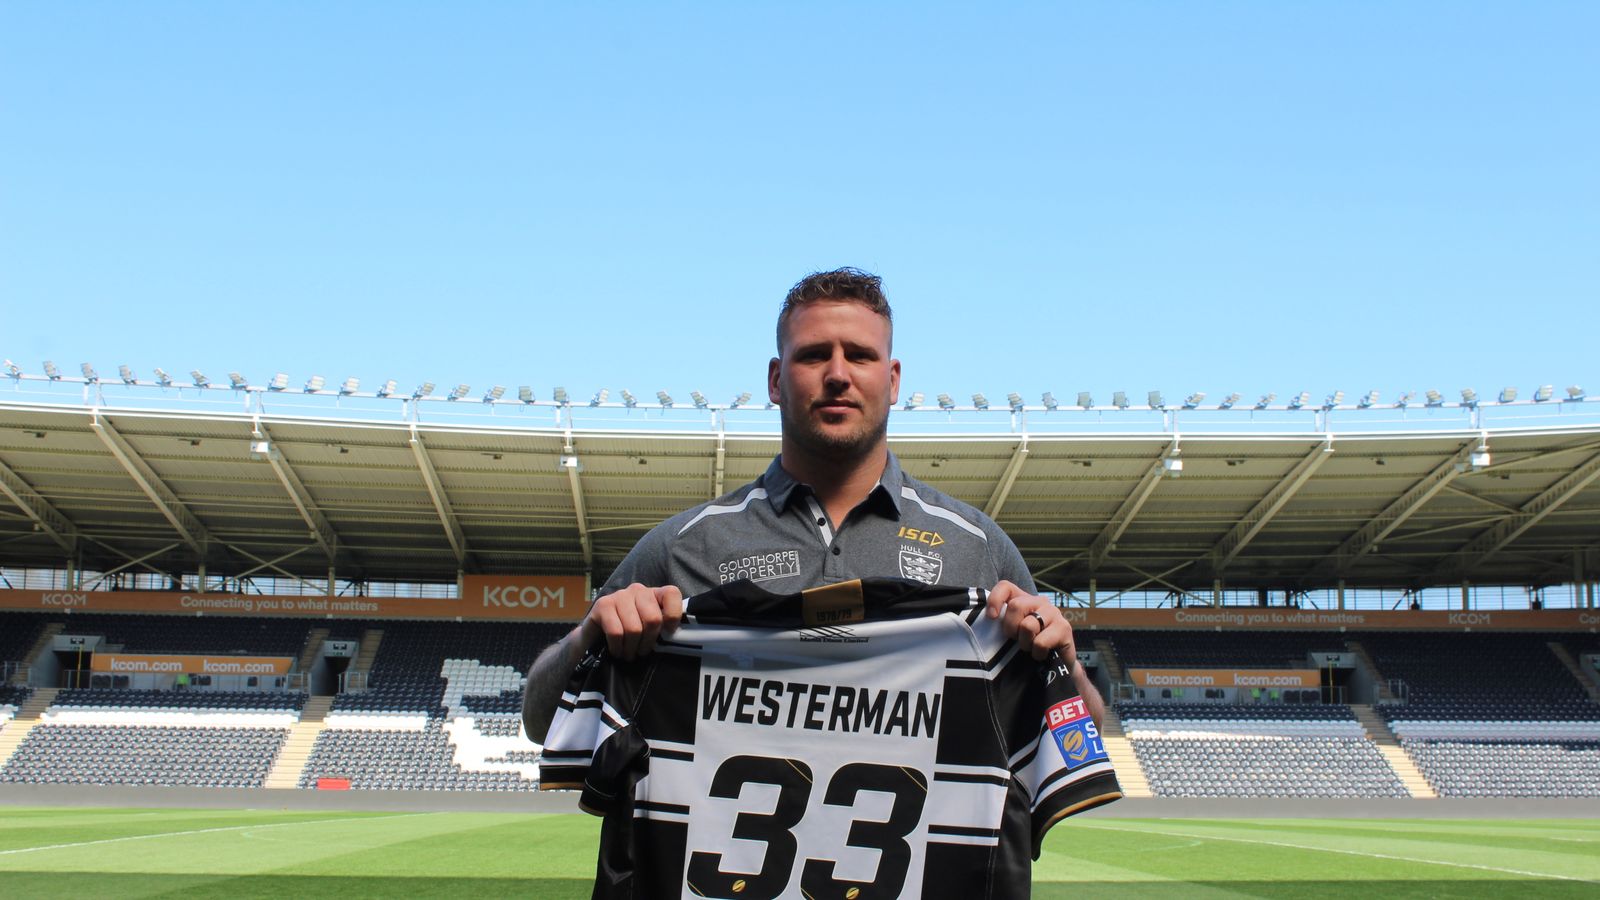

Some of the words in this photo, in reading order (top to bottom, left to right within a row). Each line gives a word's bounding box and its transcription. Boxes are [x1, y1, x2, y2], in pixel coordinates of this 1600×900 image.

[898, 526, 933, 544] ISC
[900, 544, 922, 555] HULL
[718, 550, 796, 574] GOLDTHORPE
[720, 561, 795, 585] PROPERTY
[42, 593, 87, 606] KCOM
[181, 595, 253, 611] Connecting
[256, 599, 279, 611] you
[282, 598, 294, 610] to
[297, 599, 328, 610] what
[331, 600, 379, 611] matters
[483, 585, 565, 609] KCOM
[1063, 610, 1087, 621] OM
[1175, 611, 1245, 625] Connecting
[1248, 613, 1269, 625] you
[1272, 612, 1284, 623] to
[1286, 612, 1317, 624] what
[1319, 612, 1365, 624] matters
[1449, 613, 1490, 625] KCOM
[111, 657, 182, 671] kcom.com
[203, 659, 274, 673] kcom.com
[1146, 673, 1214, 685] kcom.com
[1234, 673, 1302, 685] kcom.com
[702, 674, 941, 738] WESTERMAN
[687, 754, 928, 900] 33
